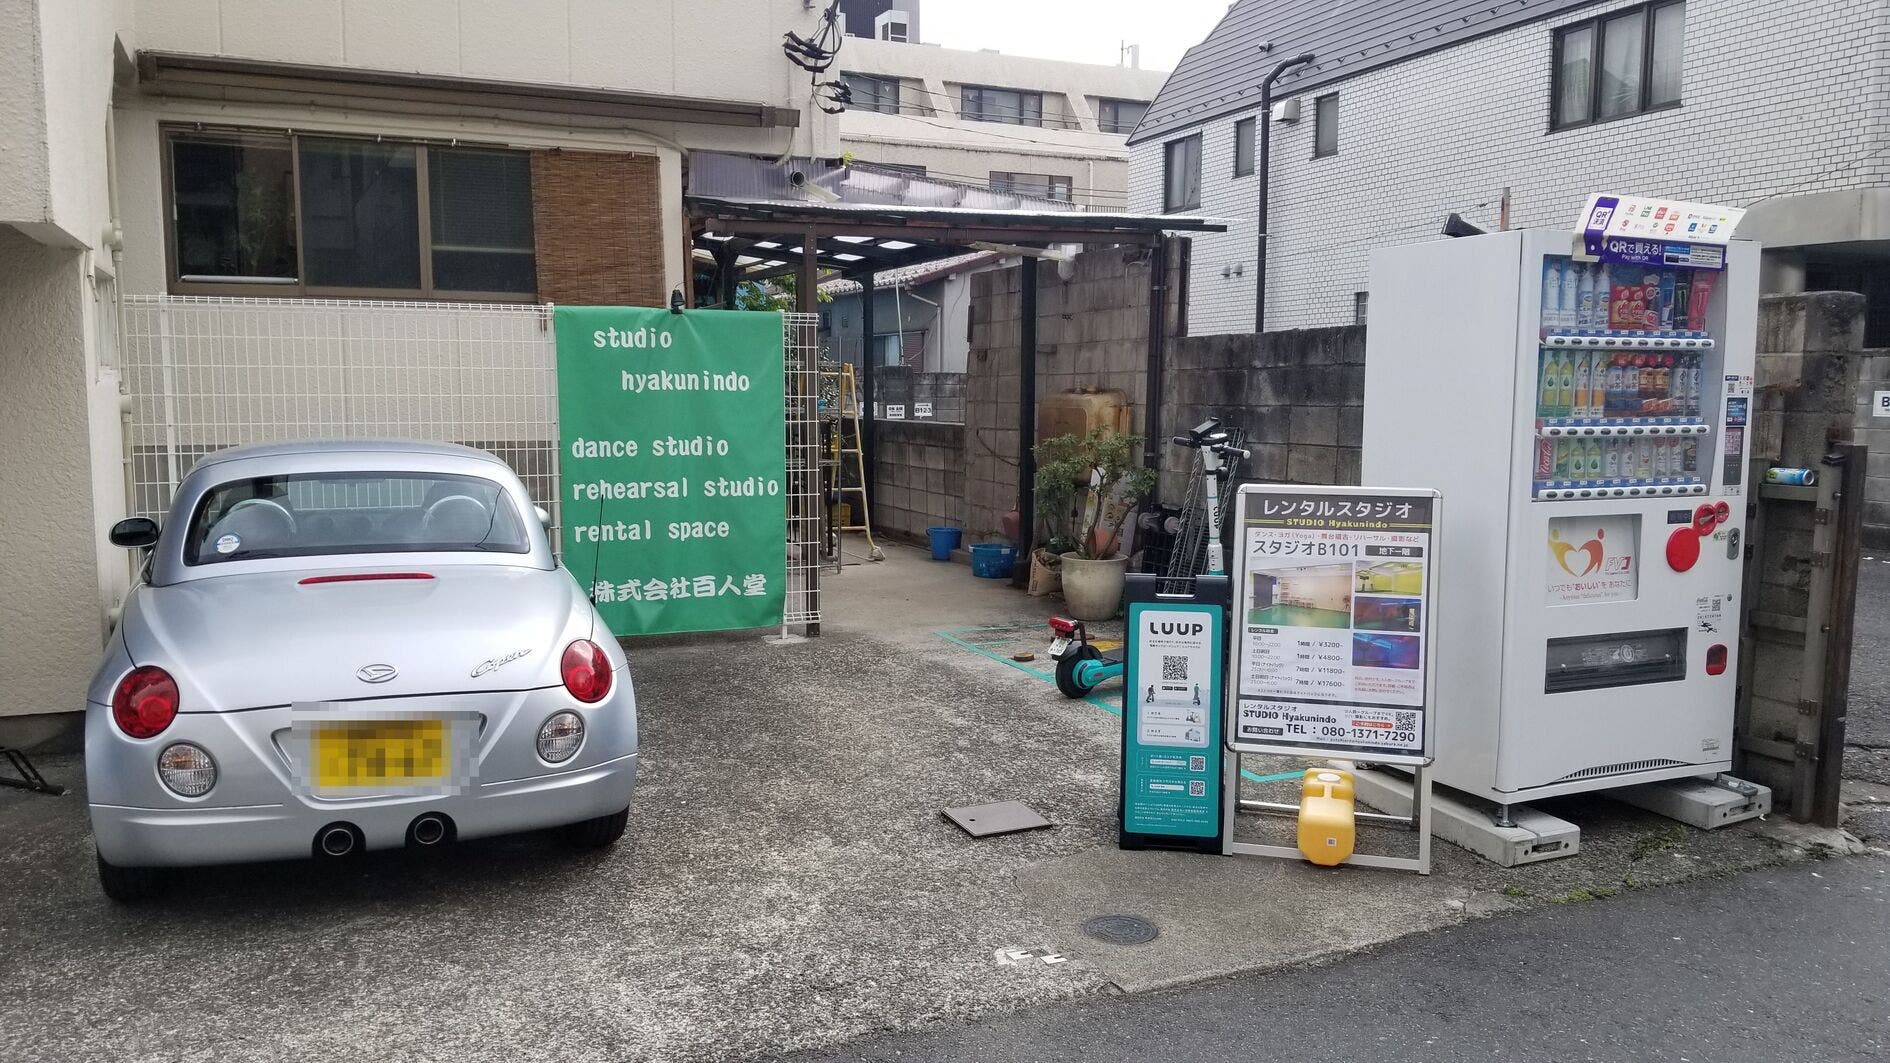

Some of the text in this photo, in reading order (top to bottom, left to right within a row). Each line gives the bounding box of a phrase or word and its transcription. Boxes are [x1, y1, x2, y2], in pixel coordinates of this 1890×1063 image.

[593, 327, 672, 348] studio
[622, 370, 750, 393] hyakunindo
[572, 436, 729, 458] dance studio
[573, 477, 779, 500] rehearsal studio
[1264, 499, 1412, 519] レンタルスタジオ
[574, 520, 730, 542] rental space
[1286, 518, 1388, 529] STUDIO Hyakunindo
[1253, 540, 1359, 557] スタジオB101
[1379, 547, 1411, 556] 地下一階
[590, 574, 767, 603] 株式会社百人堂
[1149, 622, 1204, 636] LUUP
[1243, 710, 1337, 723] STUDIO Hyakunindo
[1244, 703, 1297, 712] レンタルスタジオ
[1286, 723, 1307, 734] TEL
[1321, 726, 1416, 742] 080-1371-7290
